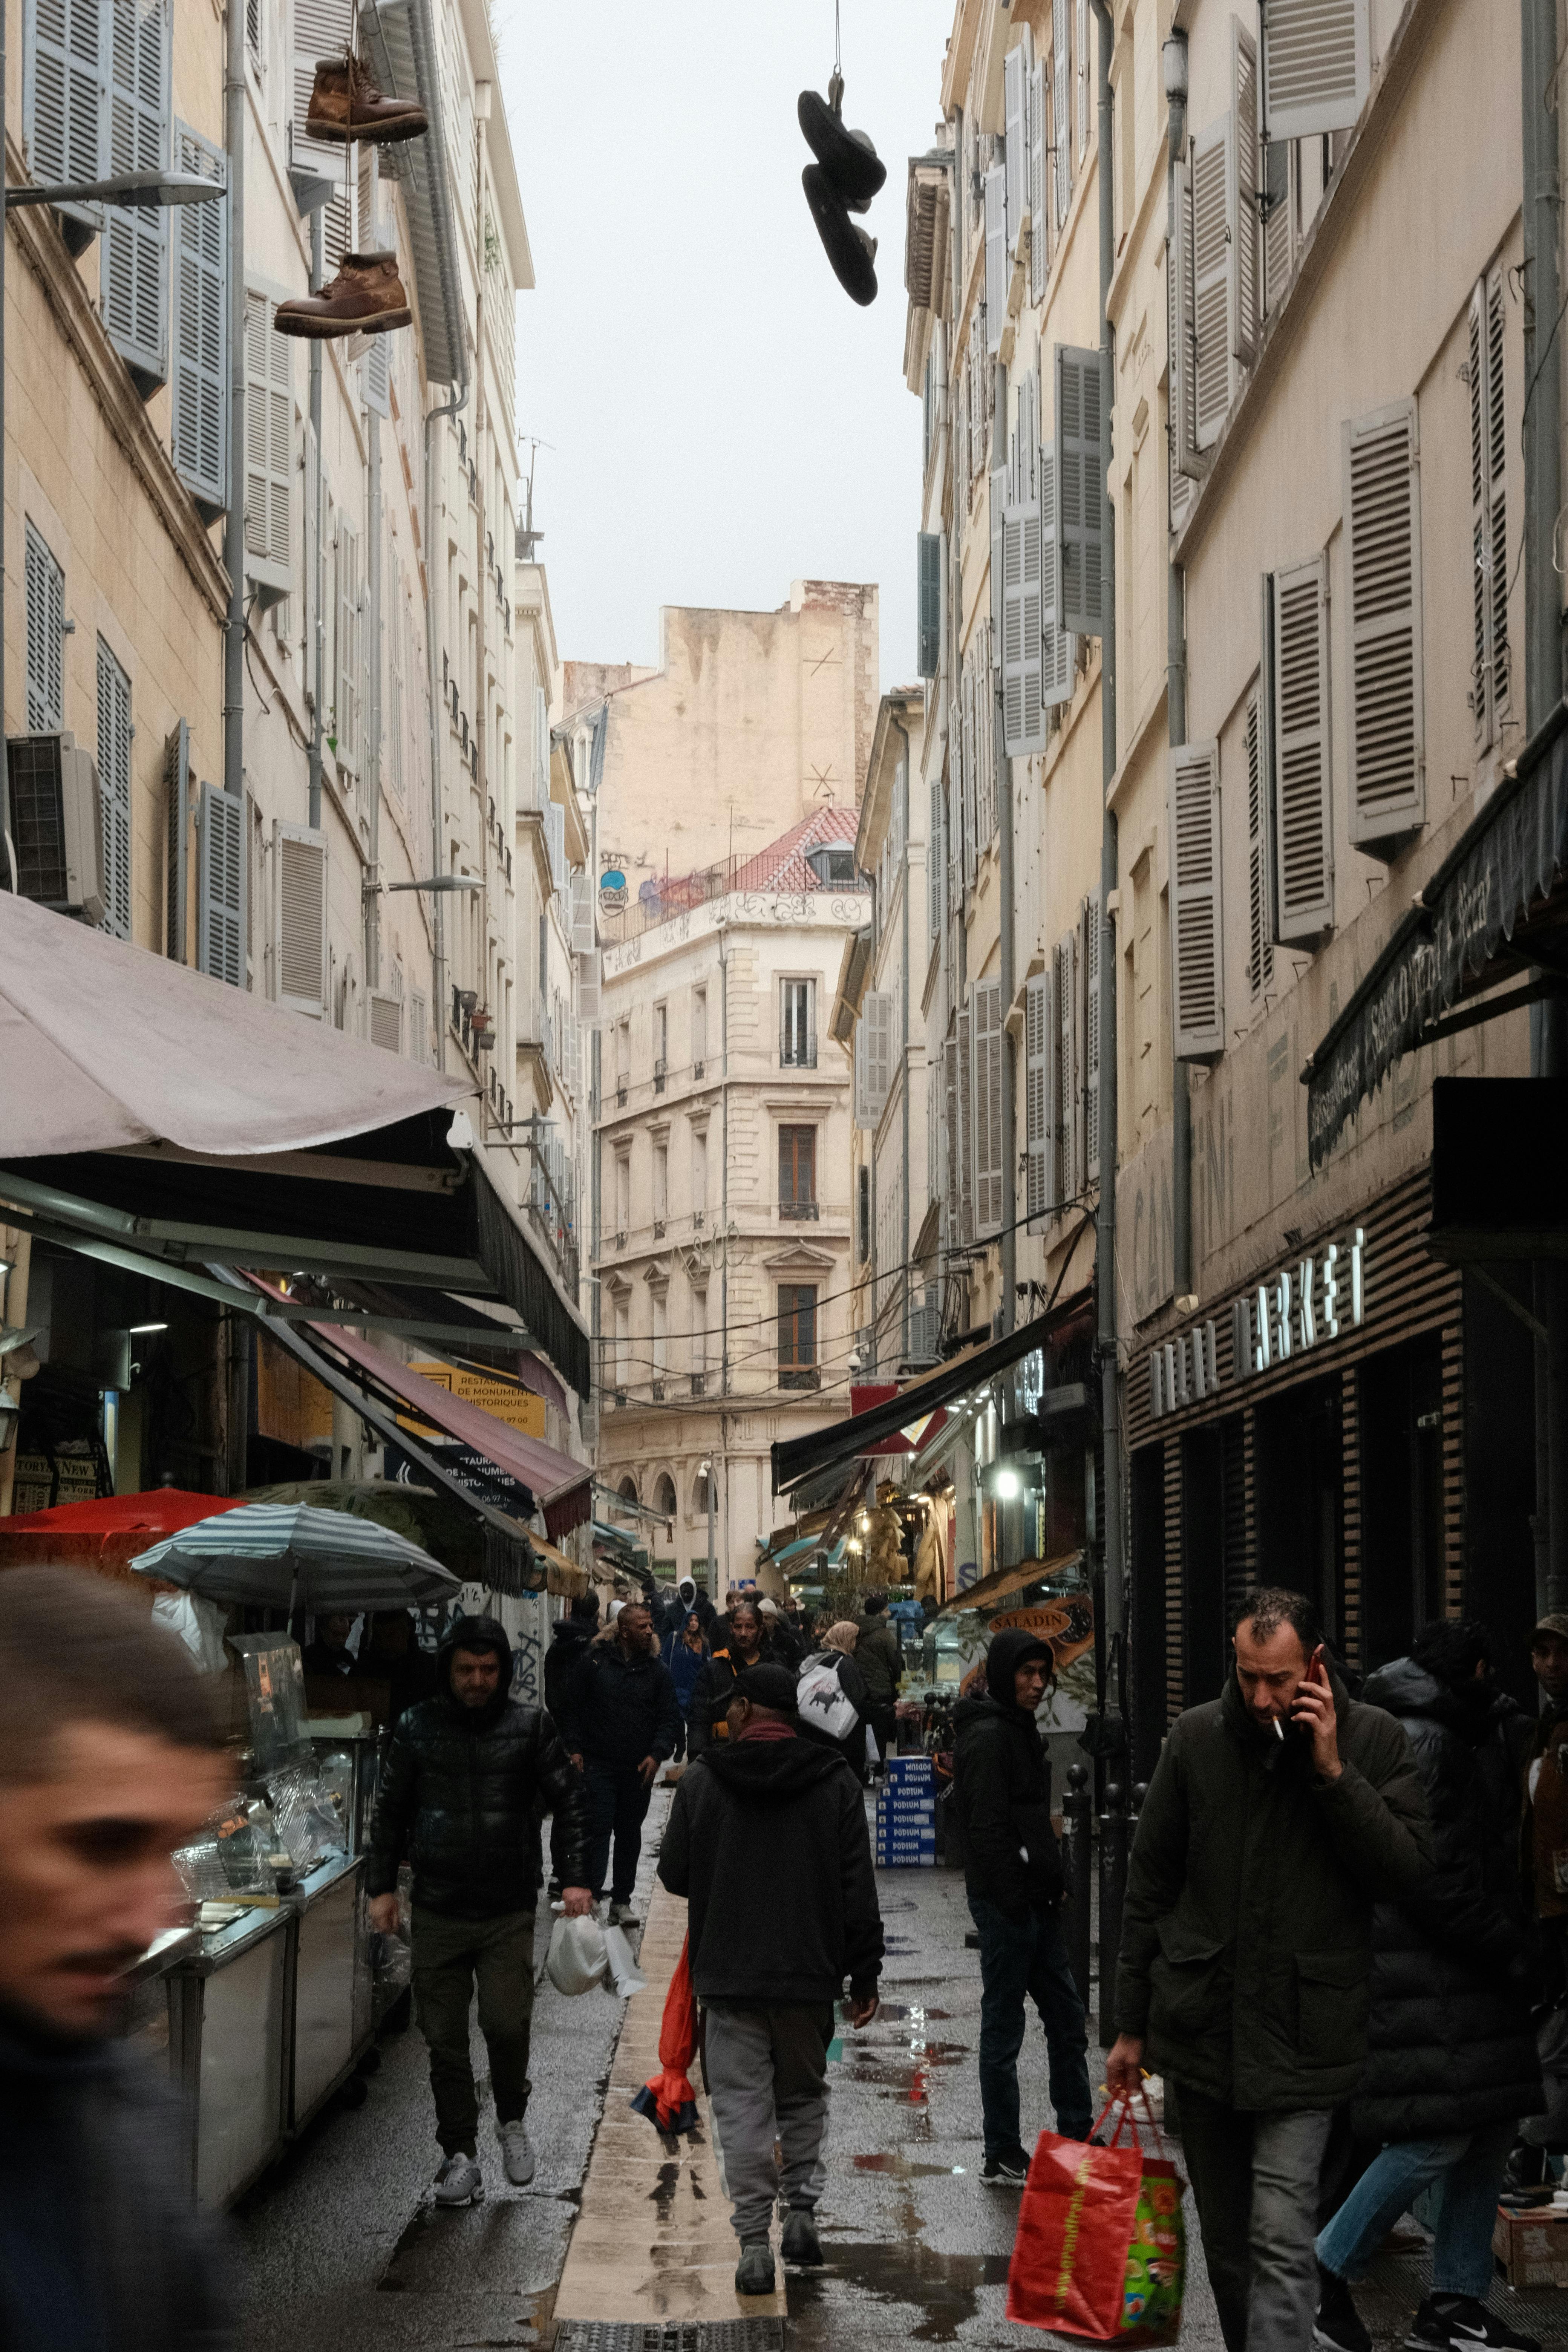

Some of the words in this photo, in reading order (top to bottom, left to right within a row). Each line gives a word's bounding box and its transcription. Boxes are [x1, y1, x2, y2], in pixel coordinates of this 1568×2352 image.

[1232, 1228, 1365, 1383] MARKET
[994, 1614, 1062, 1629] SALADIN
[905, 1763, 931, 1771] PODIUM
[905, 1773, 931, 1782] PODIUM
[897, 1787, 923, 1796] PODIUM
[893, 1801, 919, 1810] PODIUM
[893, 1815, 915, 1824] PODIU
[894, 1828, 920, 1837] PODIUM
[893, 1842, 919, 1850] PODIUM
[893, 1855, 919, 1864] PODIUM
